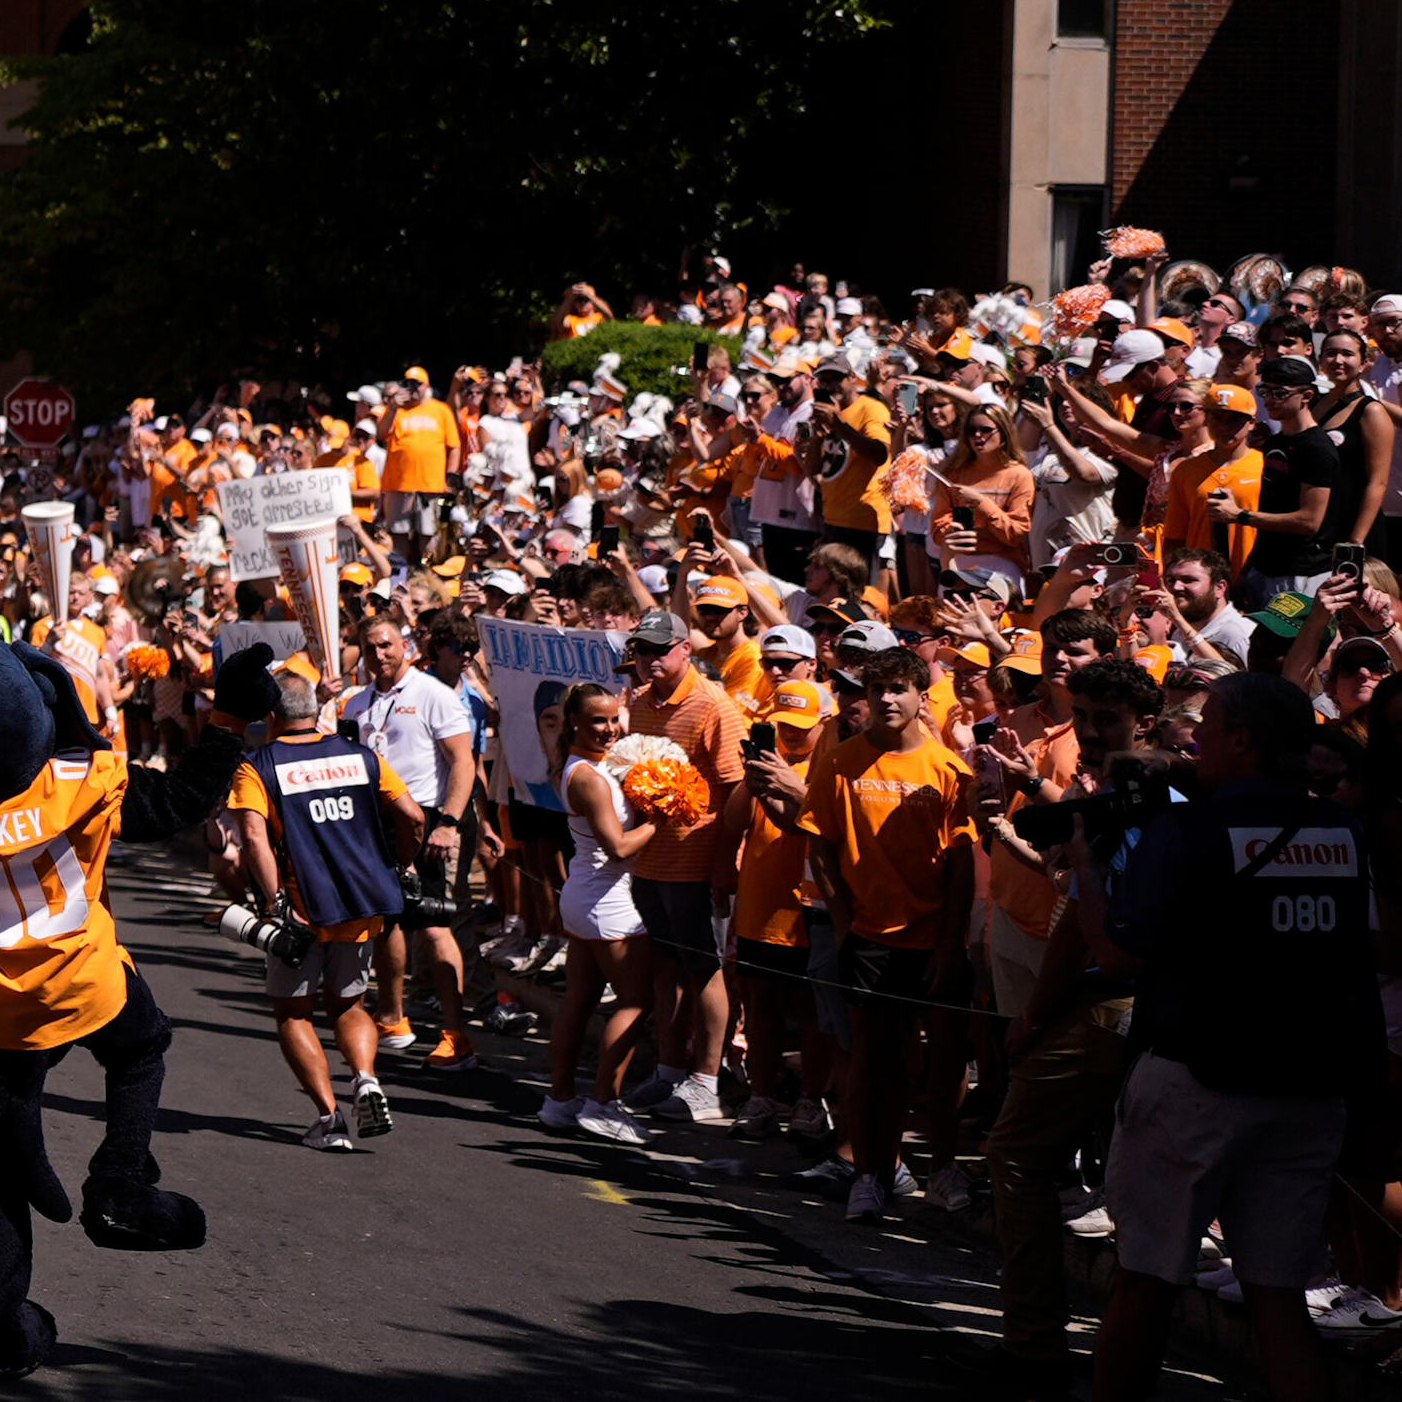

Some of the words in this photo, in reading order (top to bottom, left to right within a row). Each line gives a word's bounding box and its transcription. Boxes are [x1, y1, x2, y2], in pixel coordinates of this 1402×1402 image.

[9, 398, 70, 426] STOP
[1216, 389, 1234, 407] T
[262, 496, 335, 524] arrested
[286, 764, 359, 786] Canon
[852, 778, 940, 799] TENNESSEE
[308, 795, 355, 824] 009
[1271, 895, 1336, 932] 080
